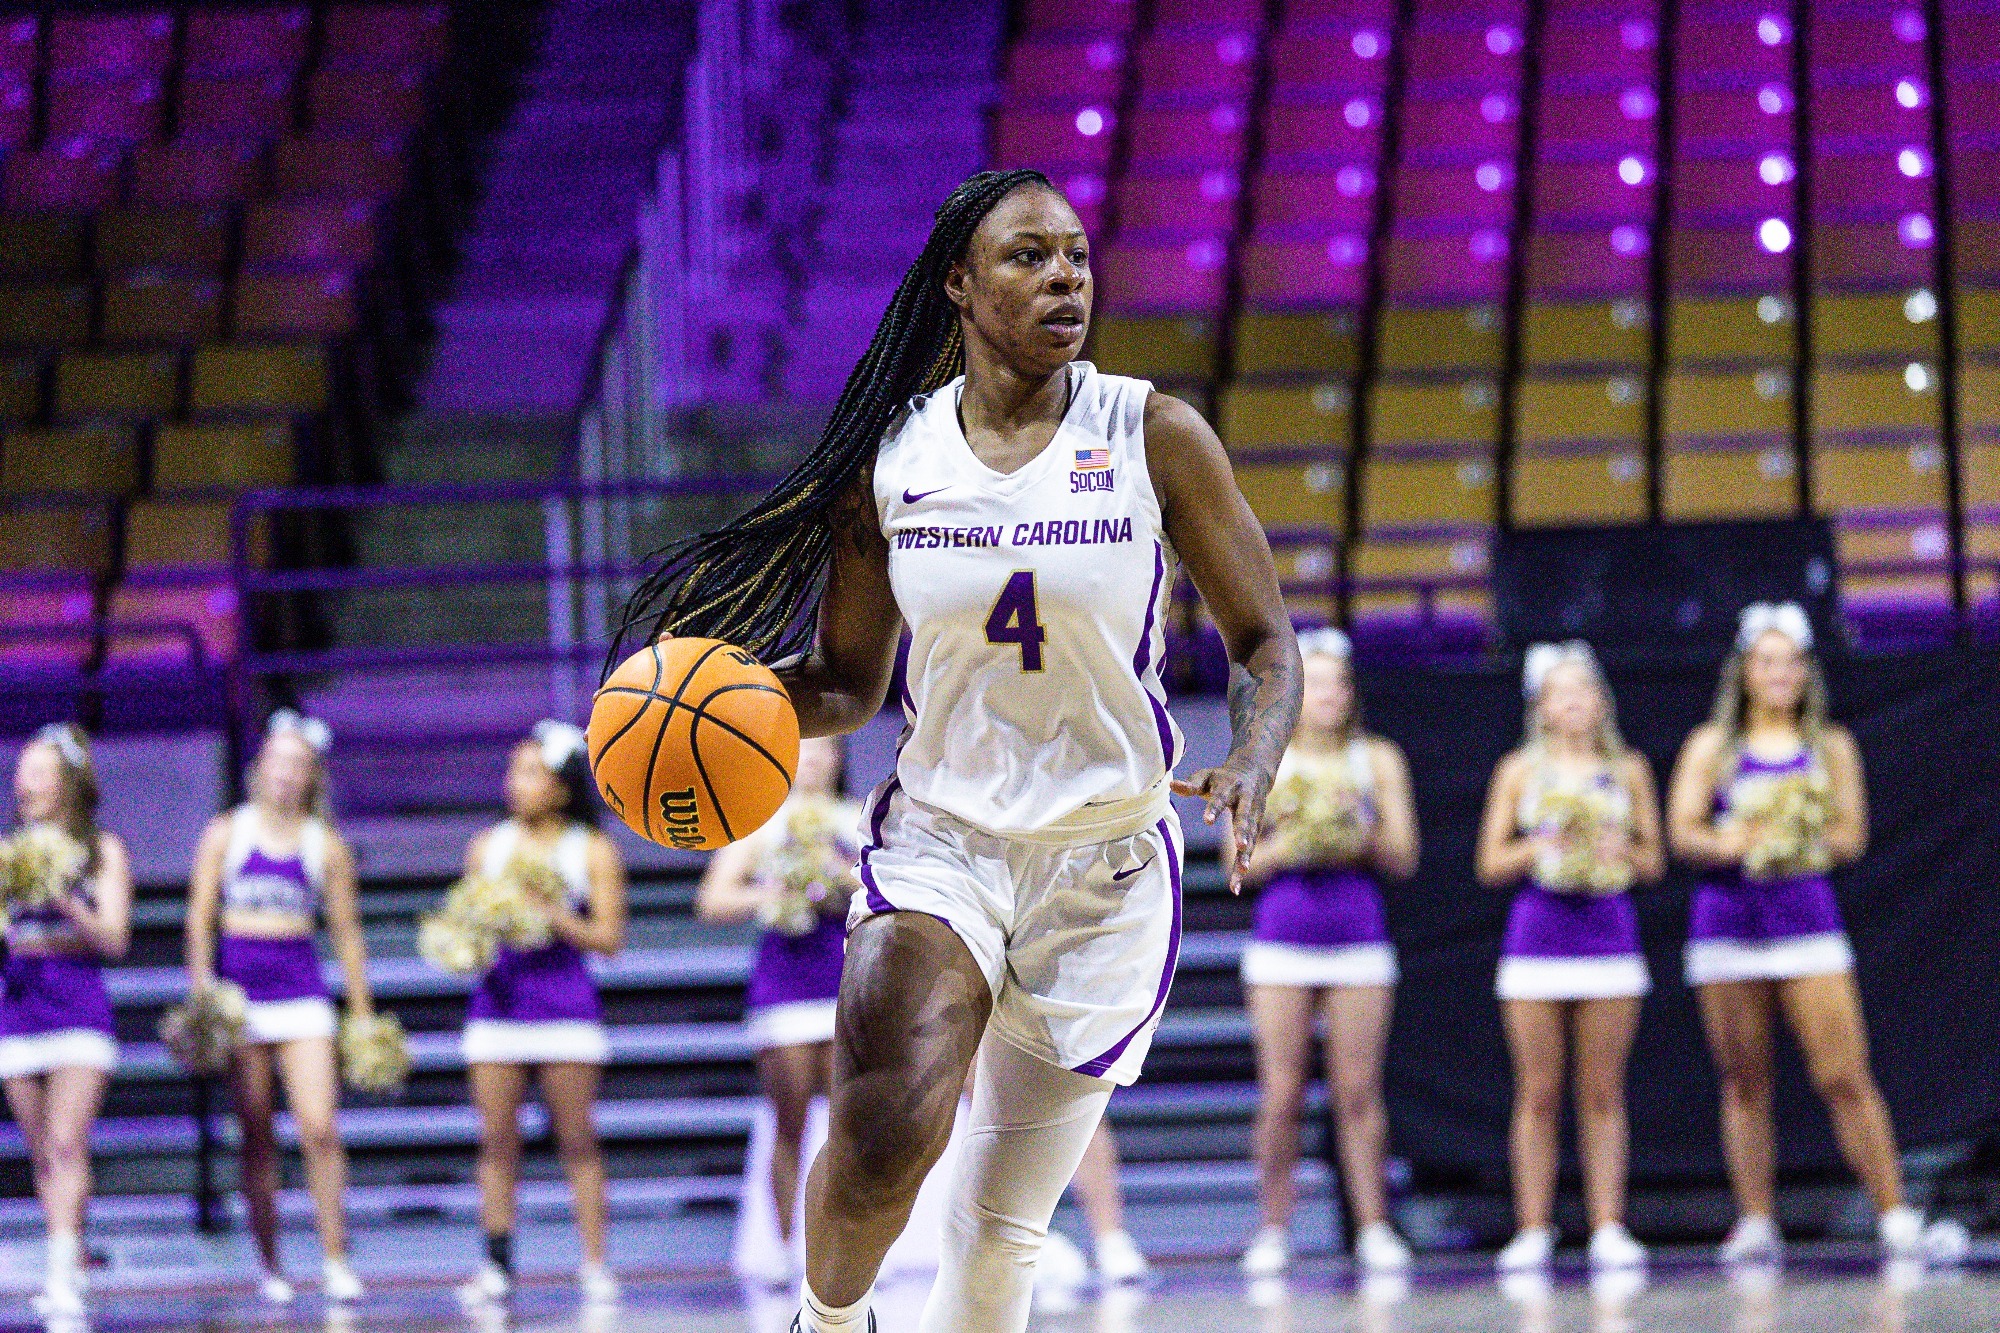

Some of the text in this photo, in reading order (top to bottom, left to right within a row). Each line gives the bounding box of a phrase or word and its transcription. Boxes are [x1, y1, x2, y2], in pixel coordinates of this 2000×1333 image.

[898, 517, 1133, 549] WESTERN CAROLINA
[982, 568, 1048, 674] 4
